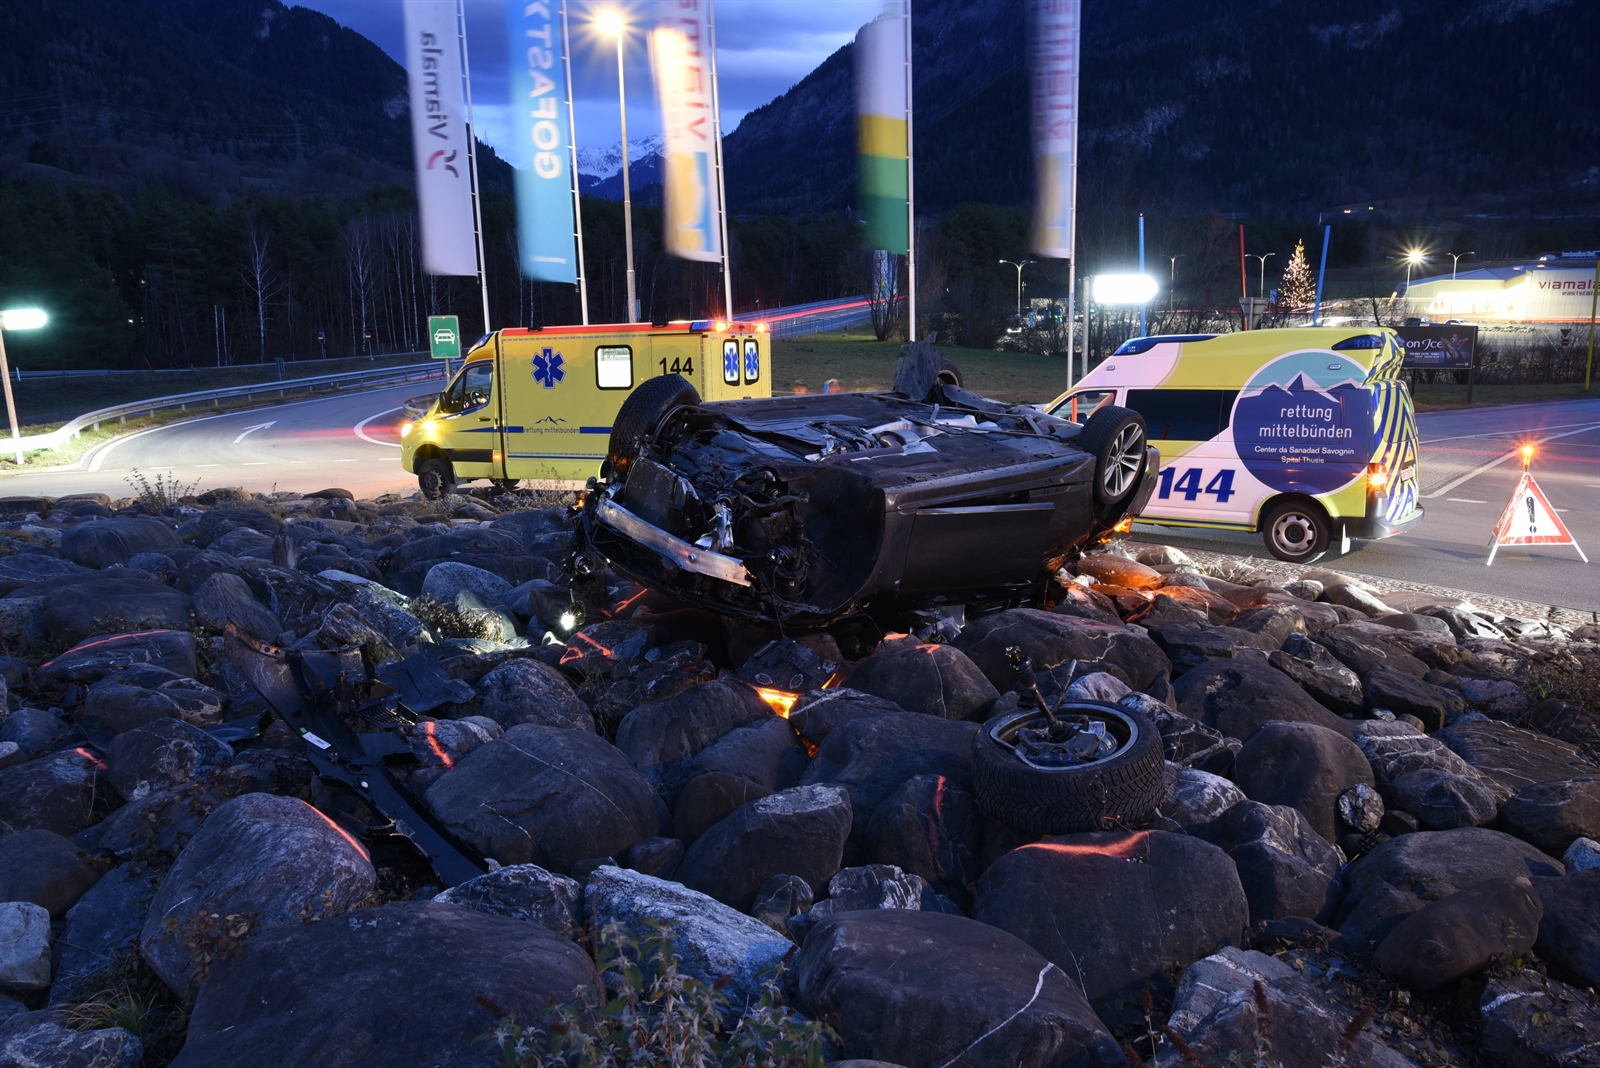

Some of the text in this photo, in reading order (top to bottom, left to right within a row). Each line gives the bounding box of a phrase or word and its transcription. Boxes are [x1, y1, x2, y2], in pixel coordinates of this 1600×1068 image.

[1406, 340, 1421, 349] on
[659, 357, 694, 376] 144
[1280, 404, 1333, 422] rettung
[523, 426, 543, 435] rettung
[1259, 423, 1353, 439] mittelbünden
[1254, 445, 1355, 457] Center da Sanadad Savognin
[1281, 455, 1301, 464] Spital
[1158, 466, 1236, 503] 144
